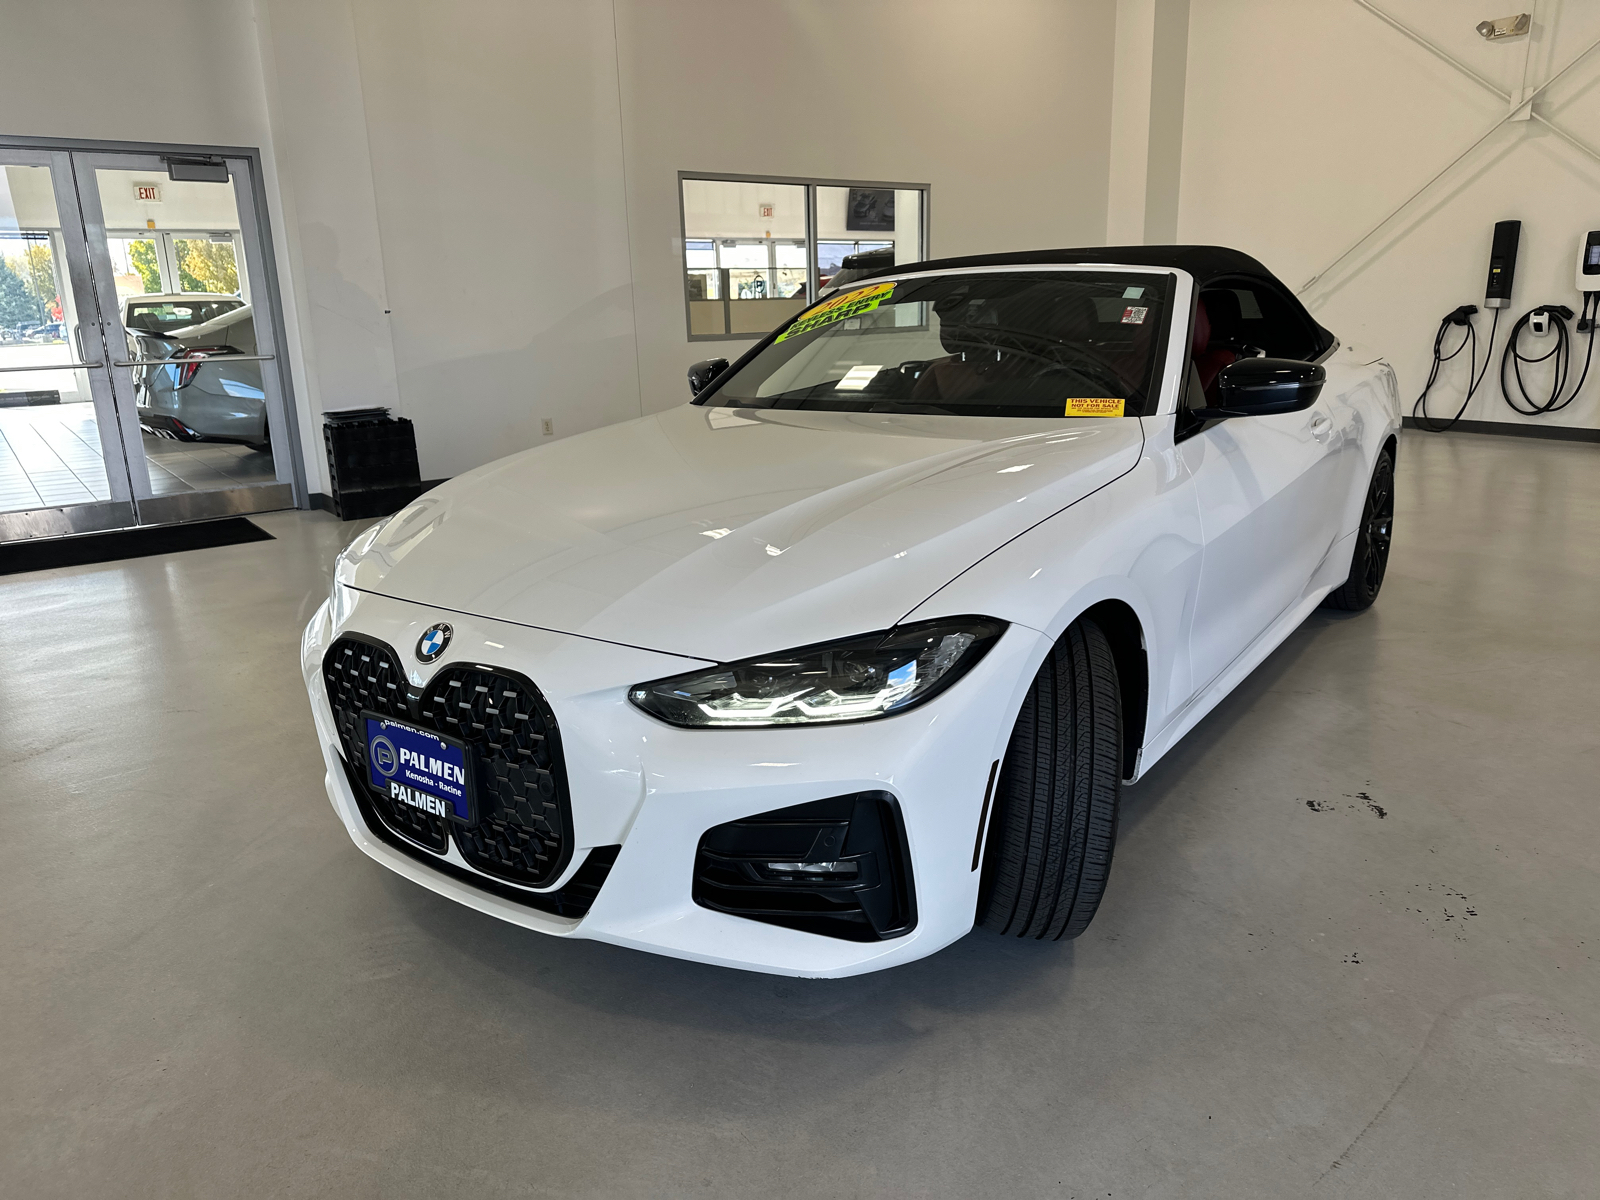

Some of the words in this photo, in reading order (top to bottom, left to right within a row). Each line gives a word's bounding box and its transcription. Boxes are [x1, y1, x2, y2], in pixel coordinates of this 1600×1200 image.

[139, 187, 156, 200] EXIT
[784, 302, 872, 339] SHARP
[384, 719, 440, 741] palmen.com
[400, 747, 465, 786] PALMEN
[405, 769, 434, 787] Kenosha
[438, 781, 462, 798] Racine
[391, 782, 446, 819] PALMEN
